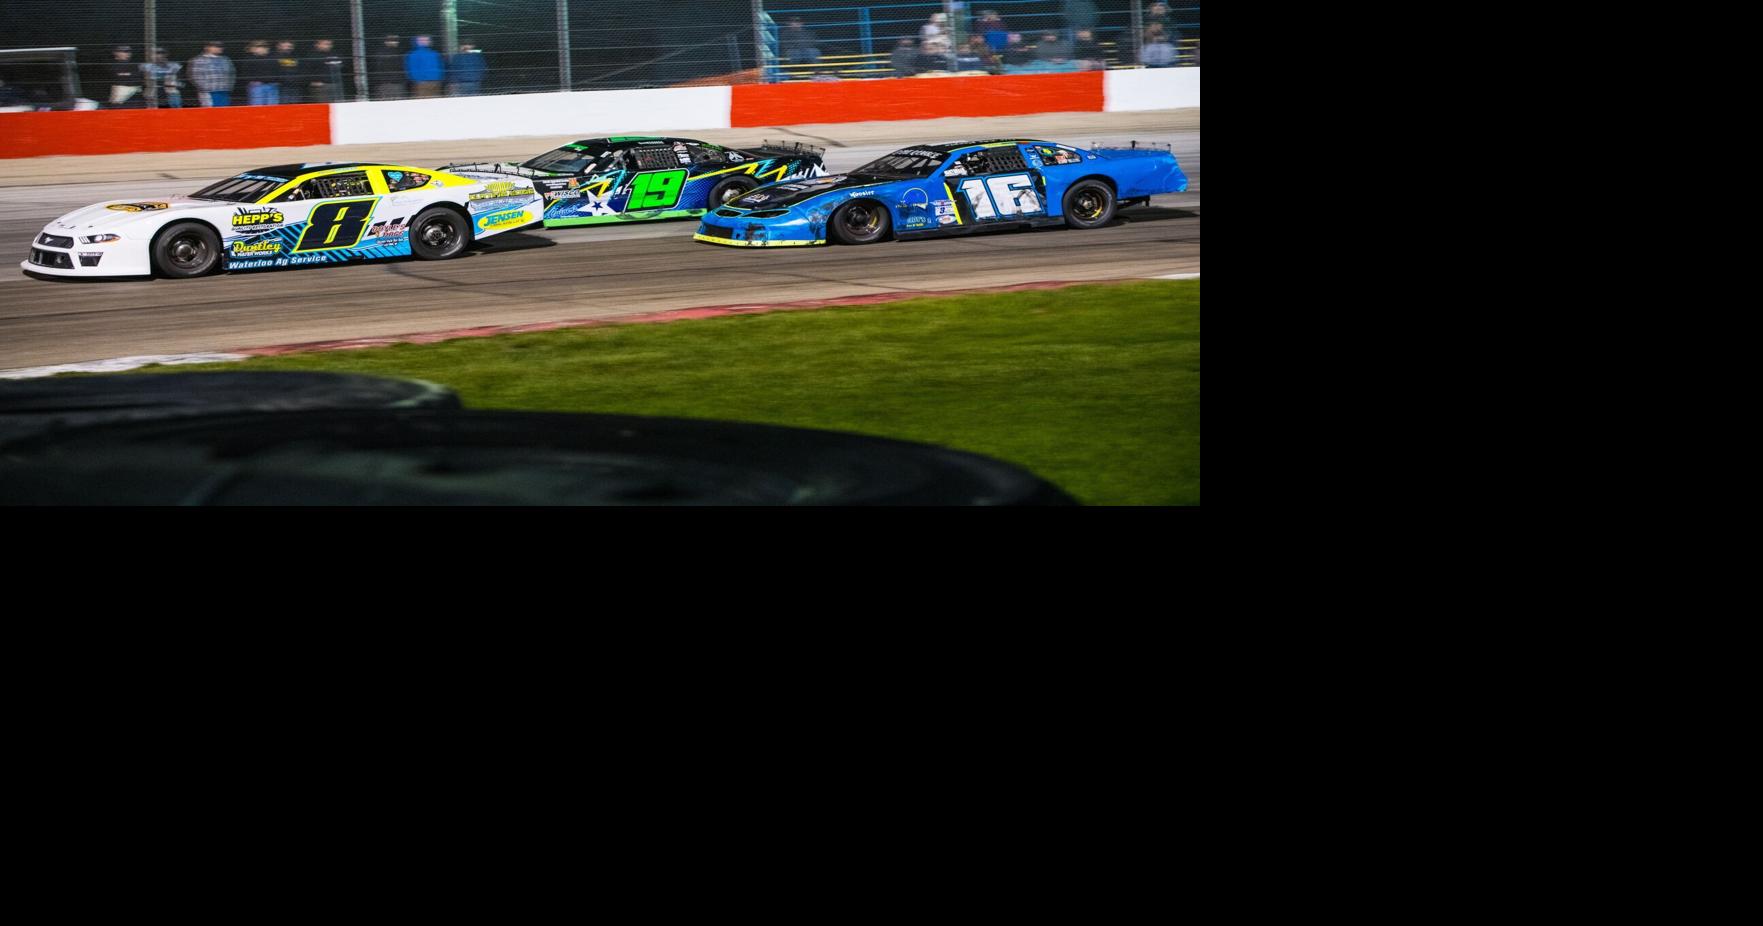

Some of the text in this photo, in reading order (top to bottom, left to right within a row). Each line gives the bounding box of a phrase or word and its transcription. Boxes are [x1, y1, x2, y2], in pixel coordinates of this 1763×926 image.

[627, 169, 687, 210] 19
[961, 174, 1043, 218] 16
[232, 212, 283, 225] HEPP'S
[296, 198, 379, 251] 8
[484, 210, 524, 226] JENSEN
[229, 255, 327, 269] Waterloo Ag Service
